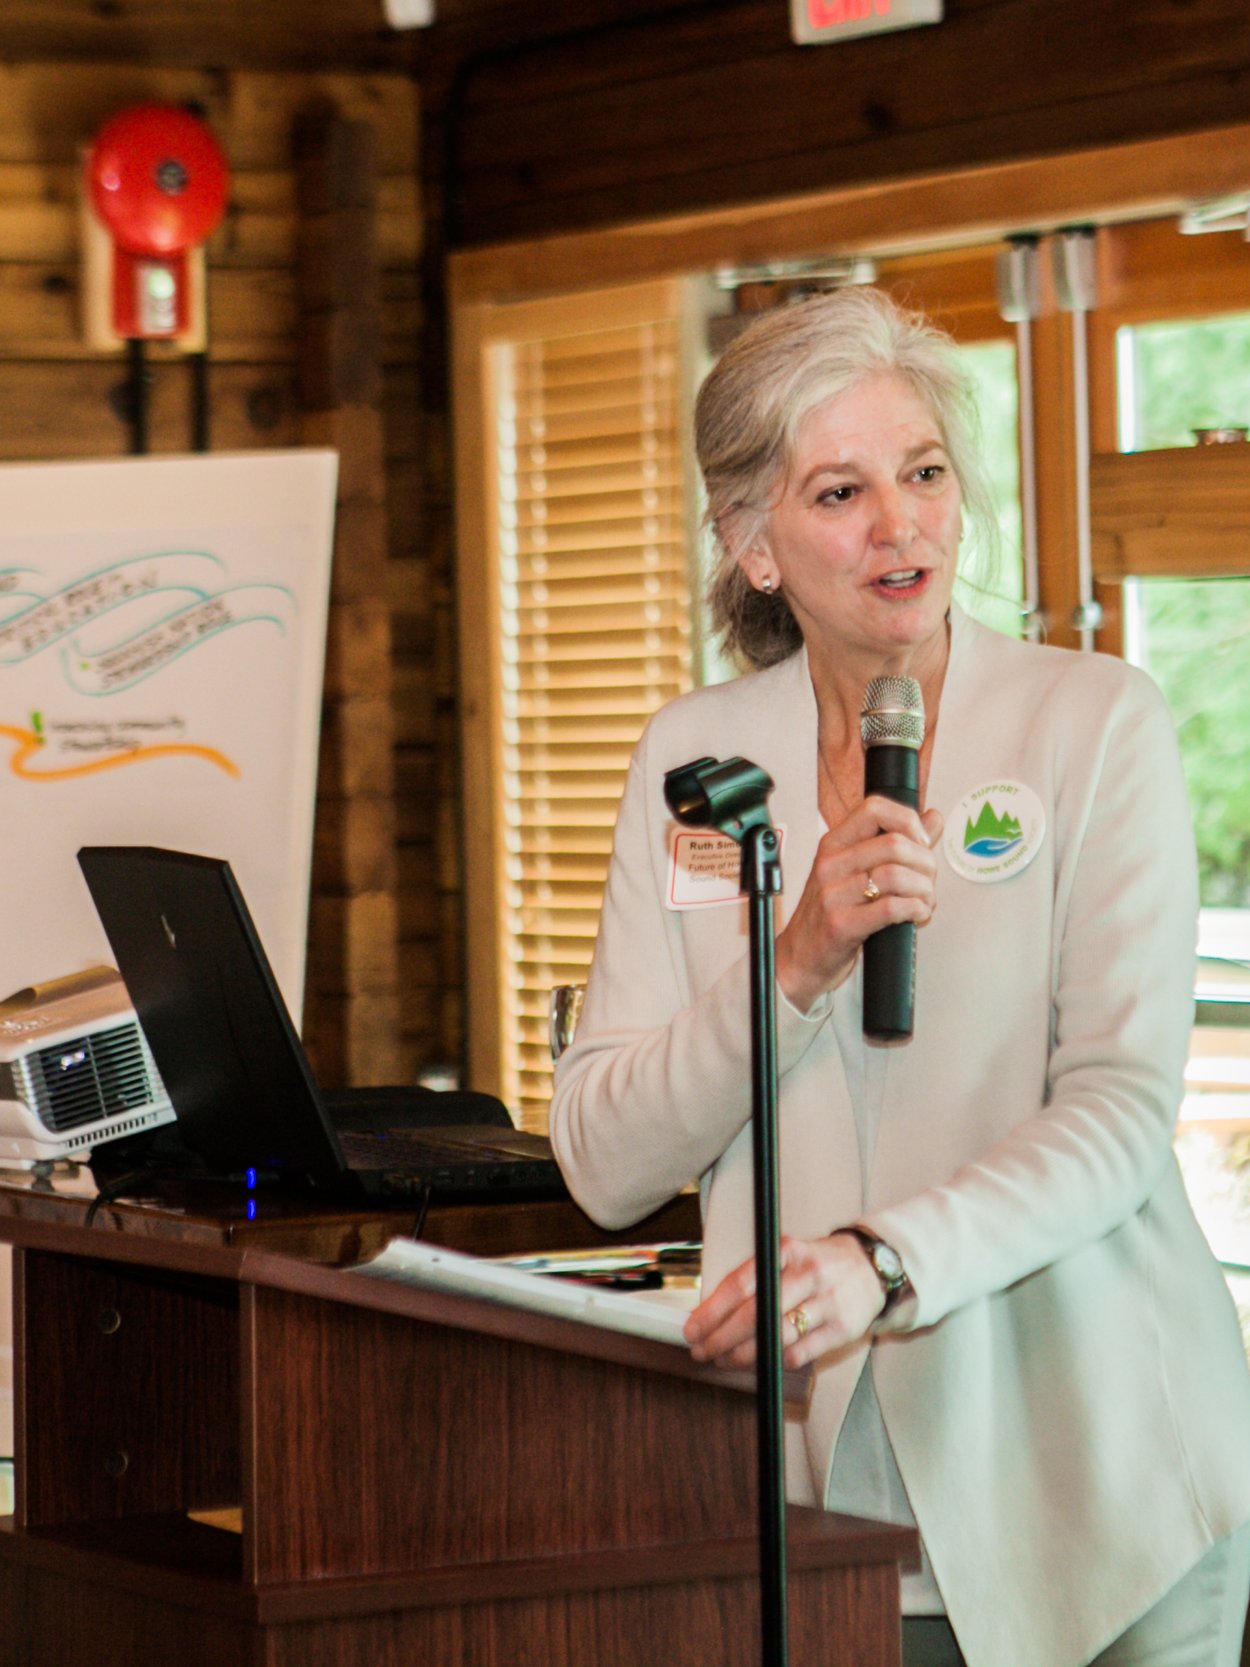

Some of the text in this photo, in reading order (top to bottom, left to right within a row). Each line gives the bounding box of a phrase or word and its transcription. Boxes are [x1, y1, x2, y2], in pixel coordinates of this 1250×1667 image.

[970, 784, 1020, 801] SUPPORT
[689, 841, 714, 851] Ruth
[688, 863, 715, 871] Future
